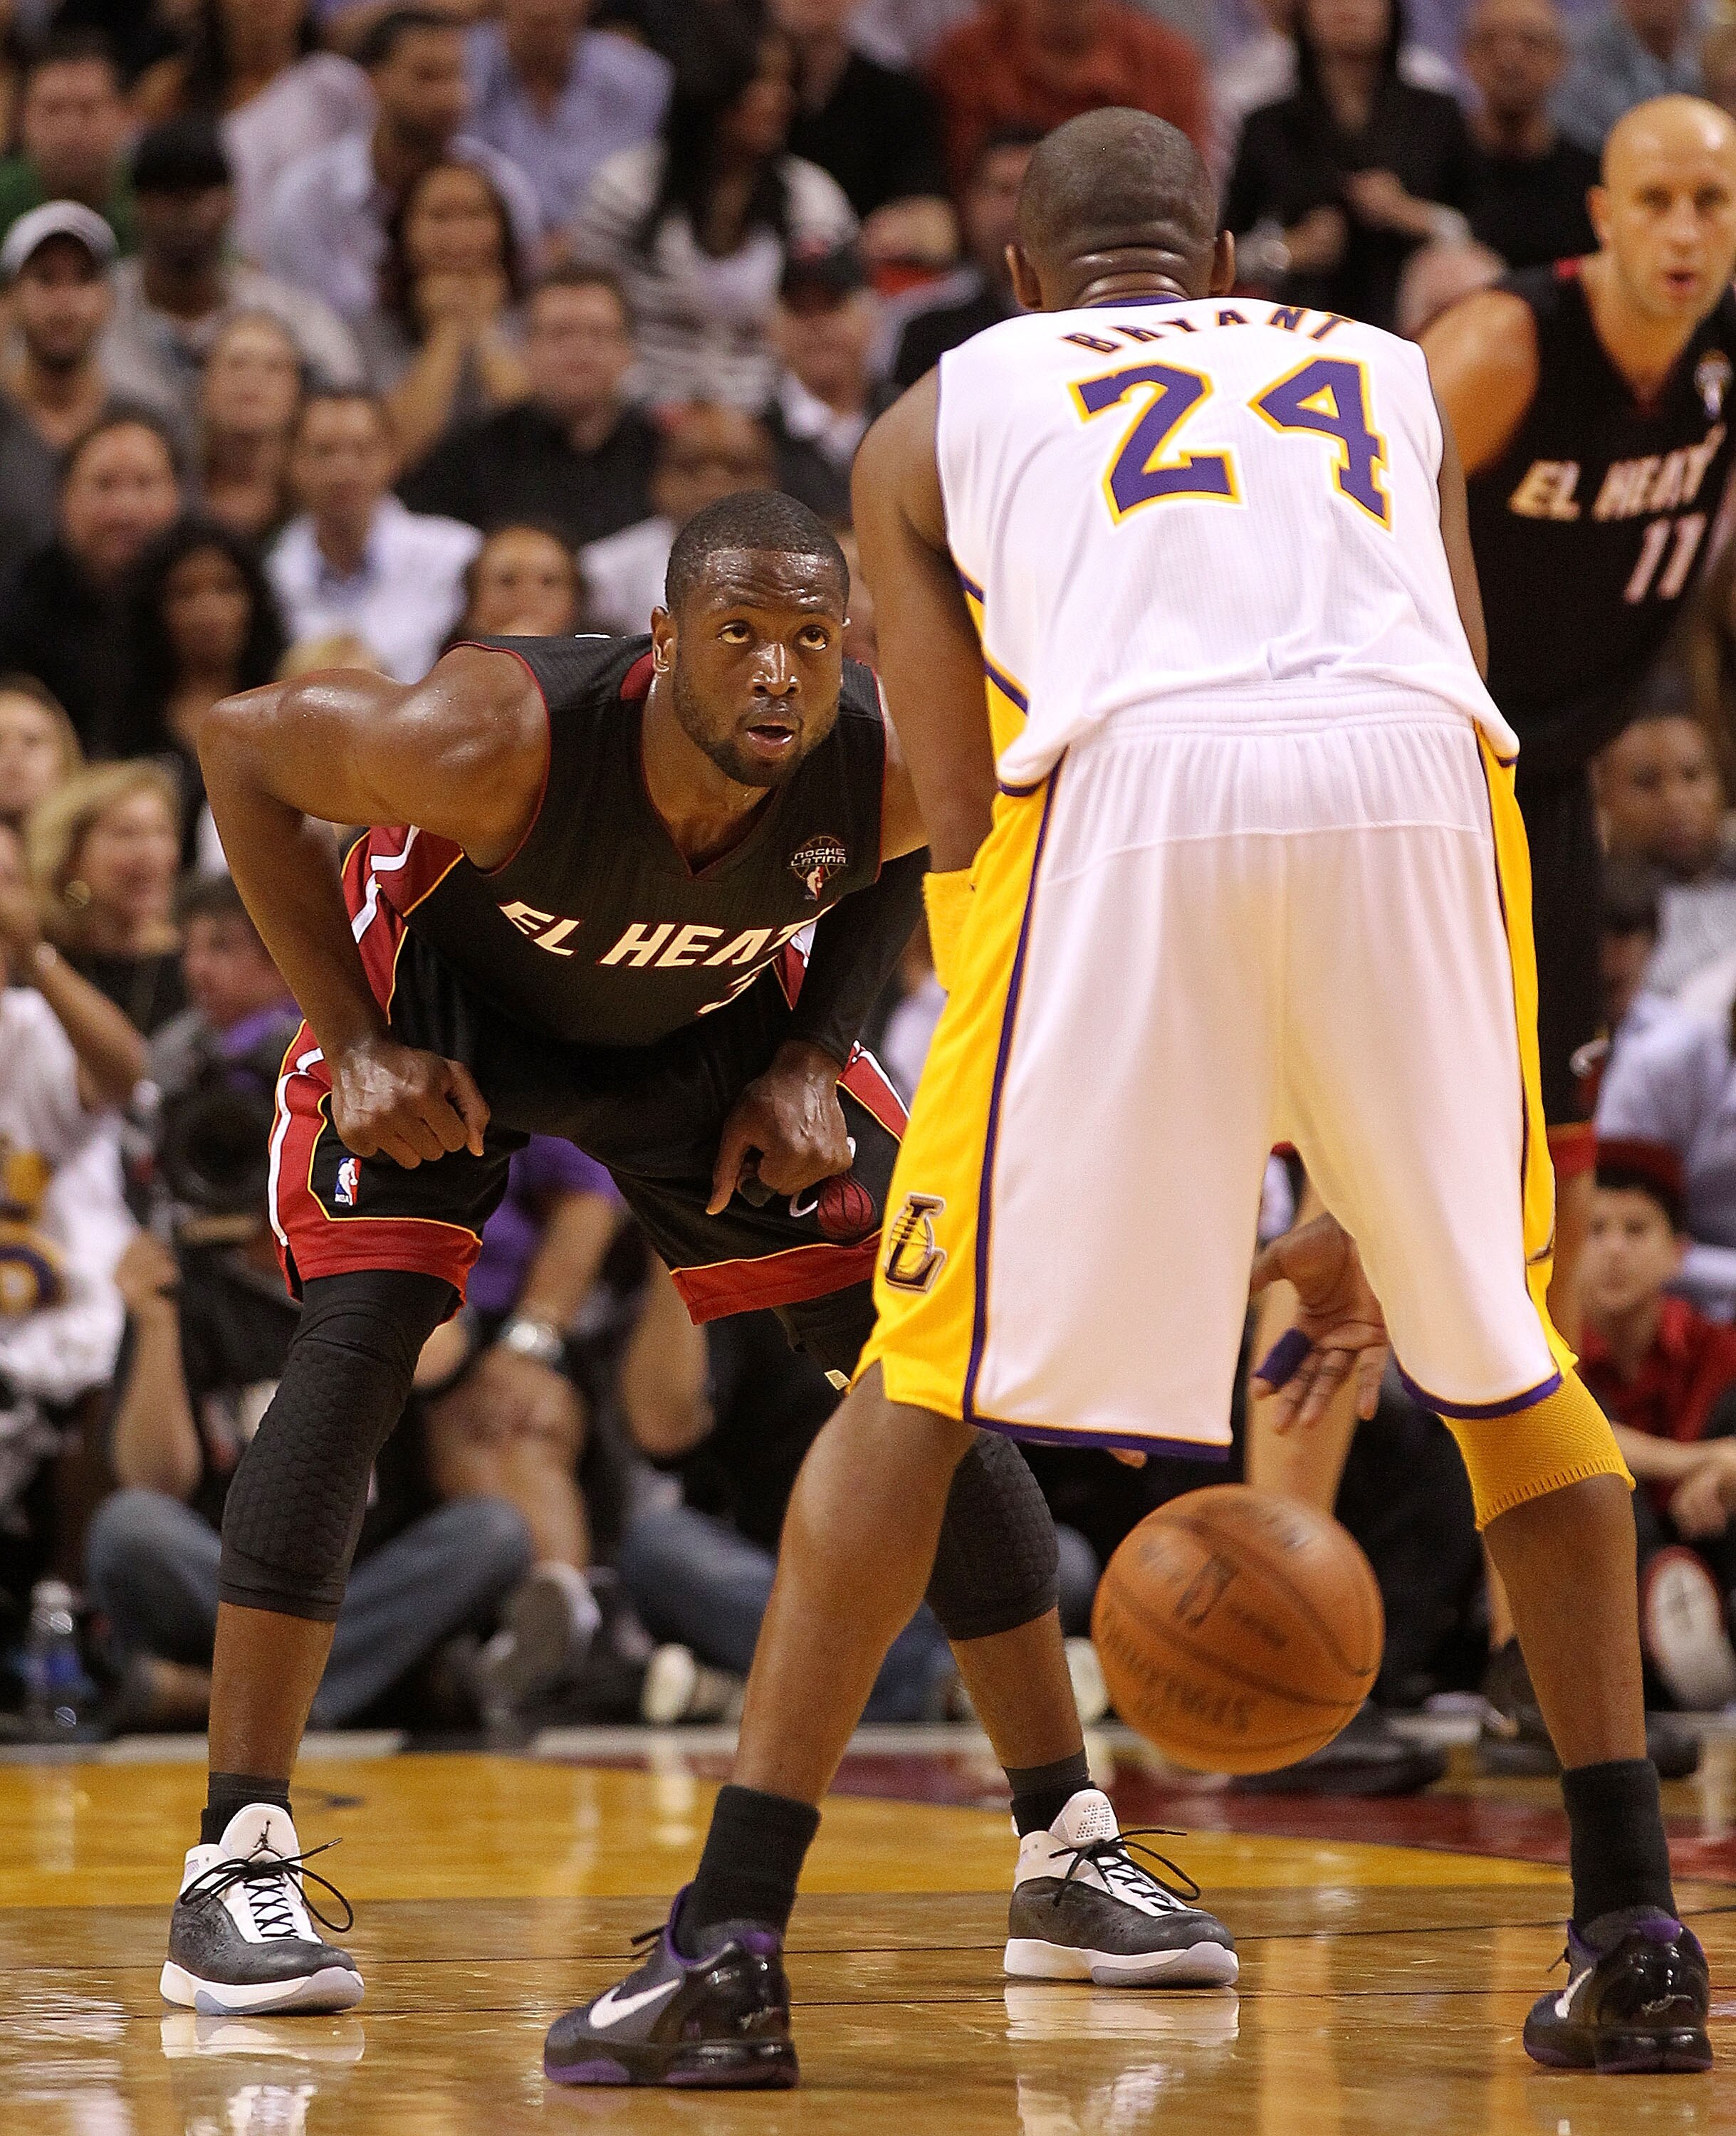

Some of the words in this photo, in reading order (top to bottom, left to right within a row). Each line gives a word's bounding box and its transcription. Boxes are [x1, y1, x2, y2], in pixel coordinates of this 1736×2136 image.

[1068, 355, 1392, 531] 24
[1509, 459, 1580, 521] EL
[1624, 513, 1706, 602] 11
[790, 856, 847, 867] LATINA
[794, 847, 846, 860] NOCHE
[498, 901, 580, 956] EL
